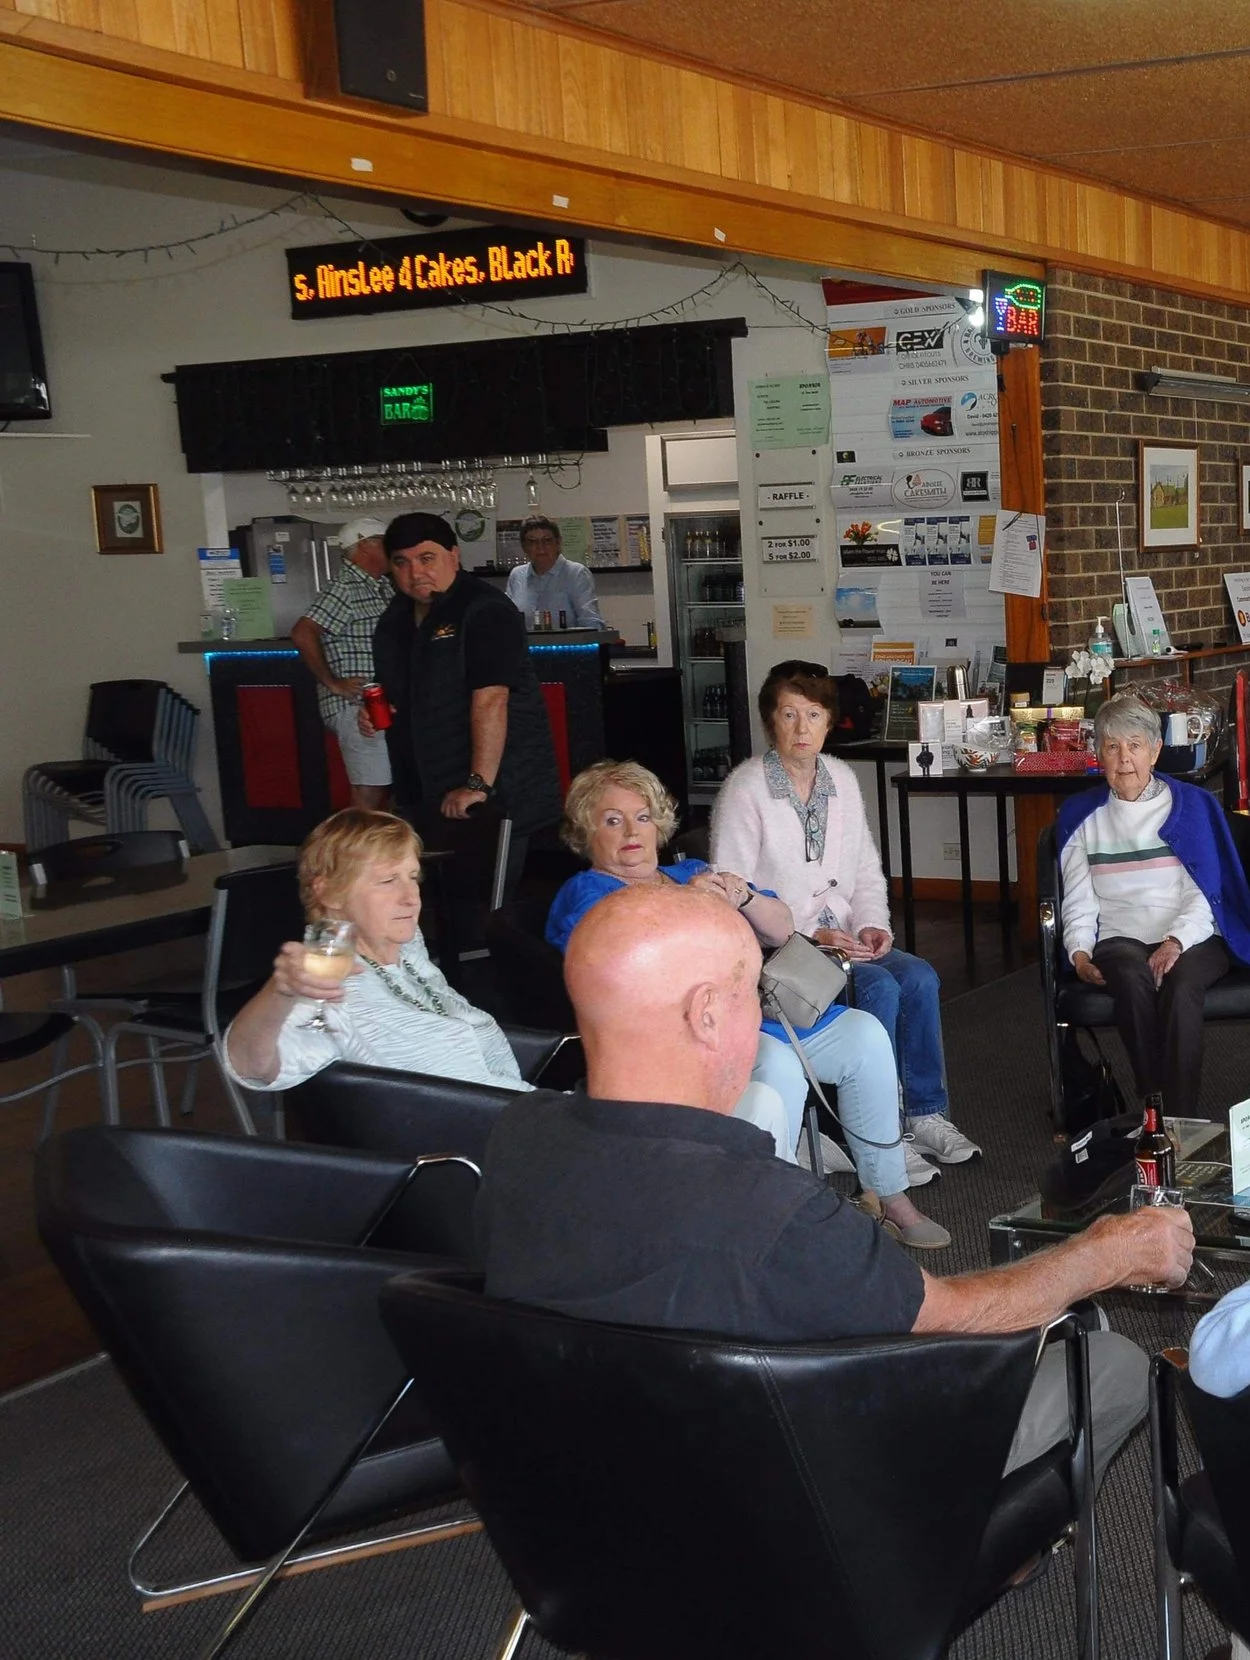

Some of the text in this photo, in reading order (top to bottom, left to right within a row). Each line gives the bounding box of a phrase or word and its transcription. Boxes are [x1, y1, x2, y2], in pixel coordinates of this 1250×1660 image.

[488, 241, 553, 282] Black
[555, 239, 575, 275] R
[900, 303, 956, 315] GOLD SPONSORS
[1007, 306, 1038, 335] BAR
[908, 374, 969, 386] SILVER SPONSORS
[383, 384, 429, 397] SANDY'S
[893, 399, 911, 407] MAP
[914, 396, 952, 405] AUTOMOTIVE
[384, 403, 411, 420] BAR
[906, 447, 971, 457] BRONZE SPONSORS
[772, 492, 805, 501] RAFFLE
[788, 539, 811, 547] $1.00
[789, 551, 811, 560] $2.00
